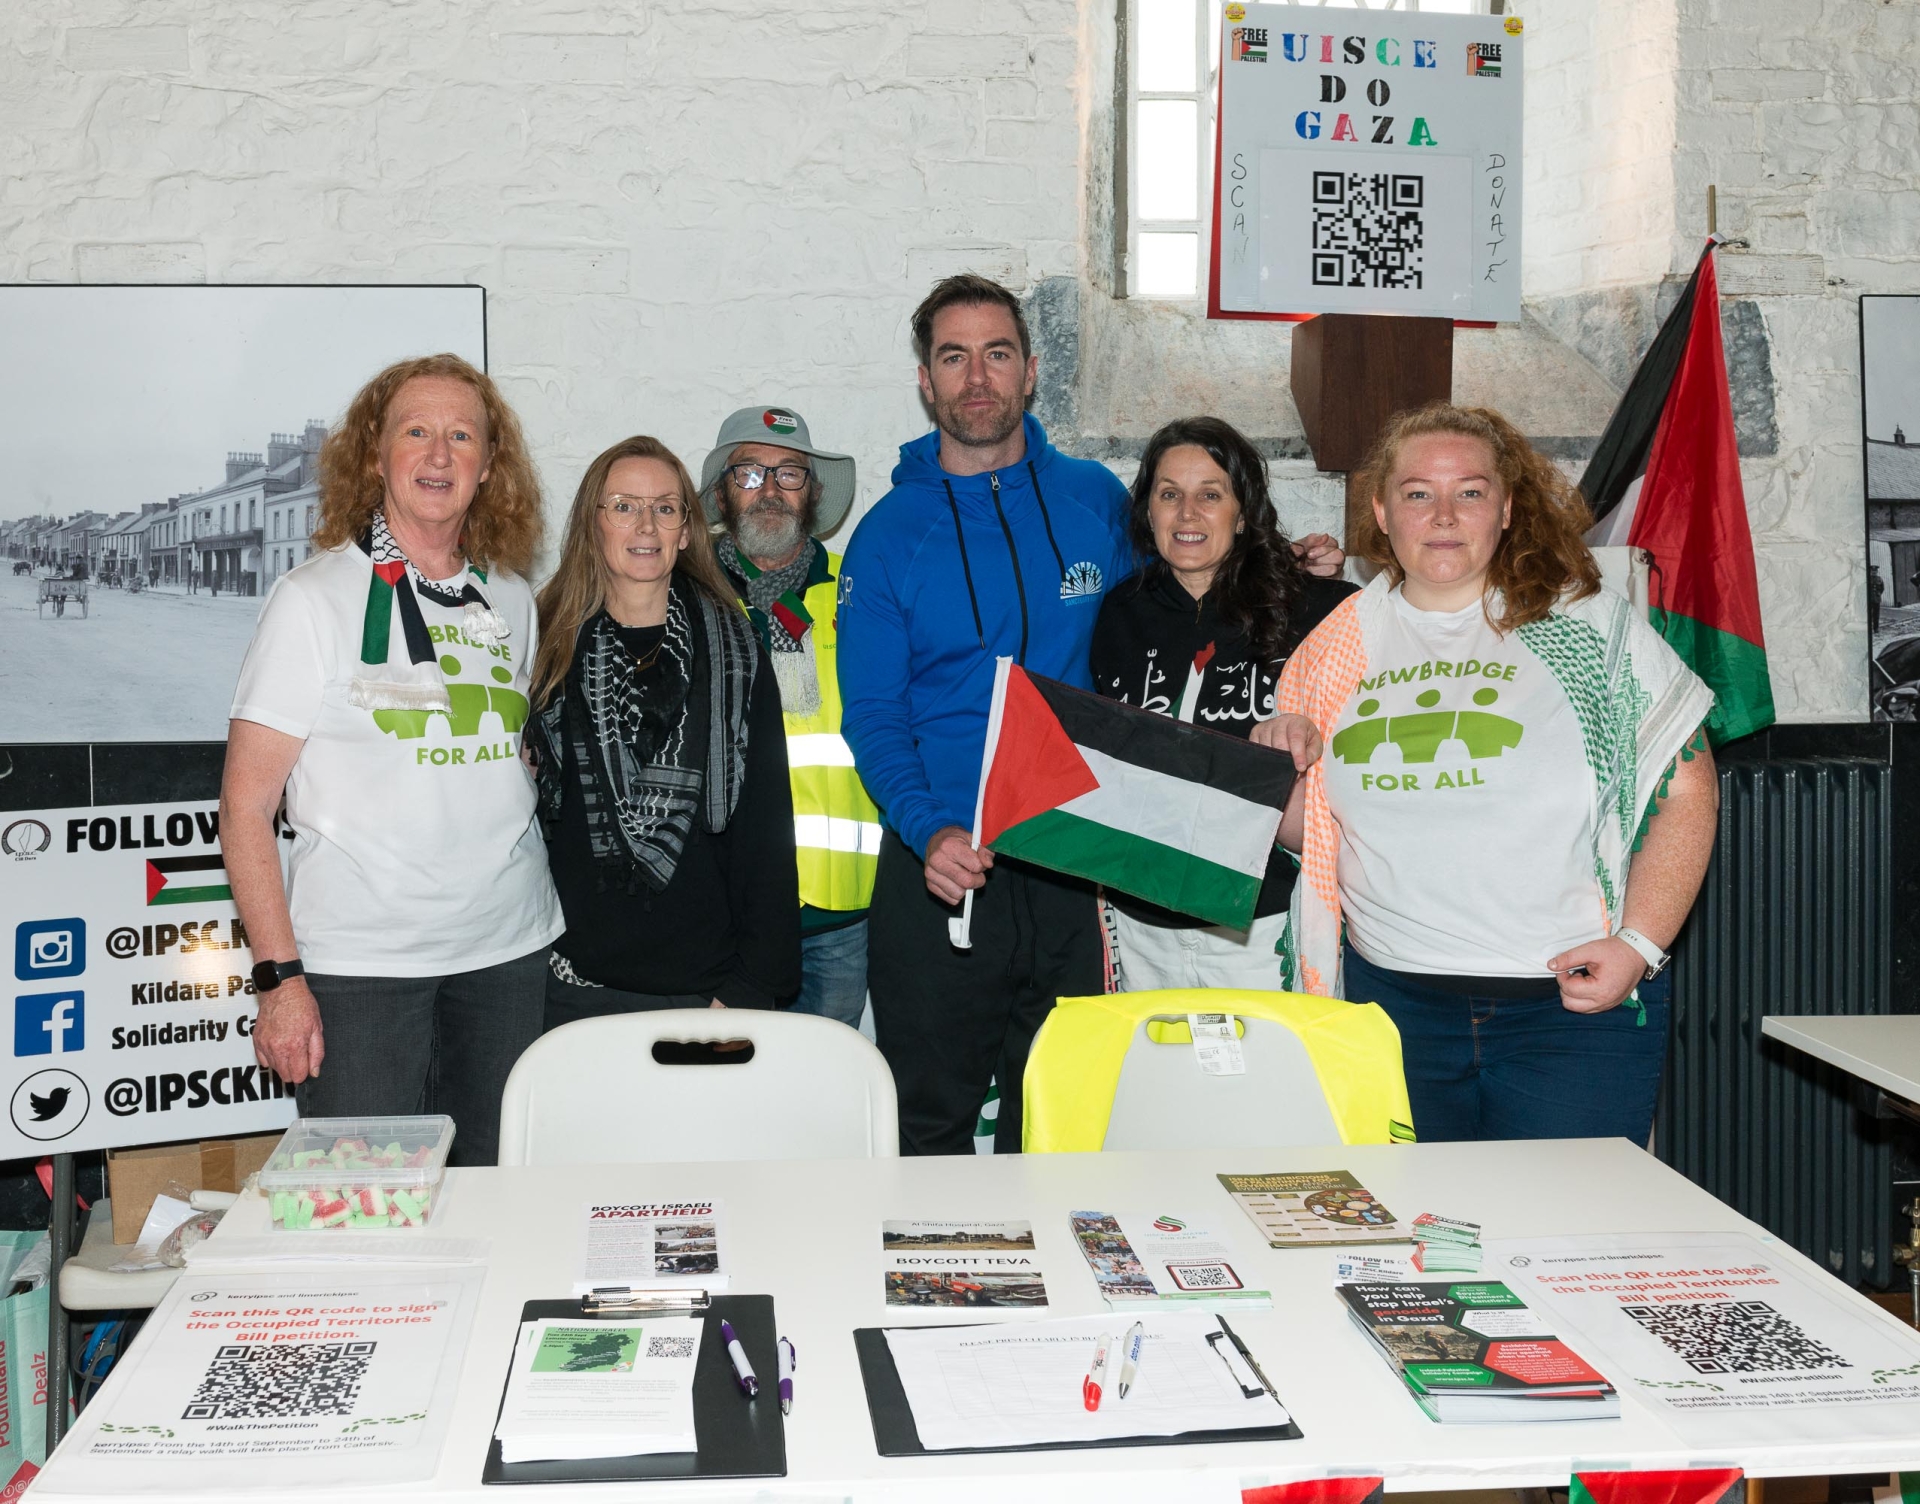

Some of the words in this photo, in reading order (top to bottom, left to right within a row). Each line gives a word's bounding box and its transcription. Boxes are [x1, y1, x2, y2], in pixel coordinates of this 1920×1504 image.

[1241, 28, 1268, 41] FREE
[1281, 33, 1437, 68] UISCE
[1476, 43, 1502, 57] FREE
[1319, 75, 1391, 107] DO
[1295, 111, 1438, 146] GAZA
[1356, 659, 1518, 695] NEWBRIDGE
[417, 748, 466, 766] FOR
[474, 742, 515, 763] ALL
[1361, 773, 1421, 791] FOR
[1434, 768, 1485, 789] ALL
[131, 978, 219, 1006] Kildare
[111, 1019, 229, 1050] Solidarity
[104, 1065, 296, 1117] @IPSCKil
[590, 1208, 713, 1219] APARTHEID
[591, 1204, 658, 1212] BOYCOTT
[896, 1257, 980, 1265] BOYCOTT
[1536, 1274, 1582, 1283] Scan
[1585, 1271, 1622, 1281] this
[1624, 1270, 1654, 1280] QR
[1656, 1269, 1701, 1279] code
[1703, 1268, 1724, 1276] to
[1727, 1267, 1767, 1276] sign
[1552, 1286, 1587, 1294] the
[1589, 1281, 1678, 1293] Occupied
[1677, 1277, 1780, 1289] Territories
[1360, 1293, 1390, 1301] you
[1392, 1292, 1426, 1300] help
[1616, 1294, 1650, 1303] Bill
[1652, 1291, 1736, 1303] petition.
[242, 1308, 280, 1317] this
[286, 1308, 315, 1316] QR
[320, 1306, 367, 1314] code
[397, 1304, 438, 1313] sign
[1367, 1301, 1399, 1309] stop
[1373, 1307, 1440, 1317] genocide
[1396, 1314, 1445, 1322] Gaza?
[186, 1321, 220, 1330] the
[226, 1319, 320, 1330] Occupied
[326, 1316, 432, 1326] Territories
[272, 1331, 360, 1343] petition.
[30, 1350, 48, 1406] Dealz
[1740, 1374, 1843, 1384] #WalkThePetition
[1808, 1388, 1866, 1397] September
[1673, 1401, 1732, 1409] September
[206, 1422, 319, 1431] #WalkThePetition
[252, 1439, 315, 1447] September
